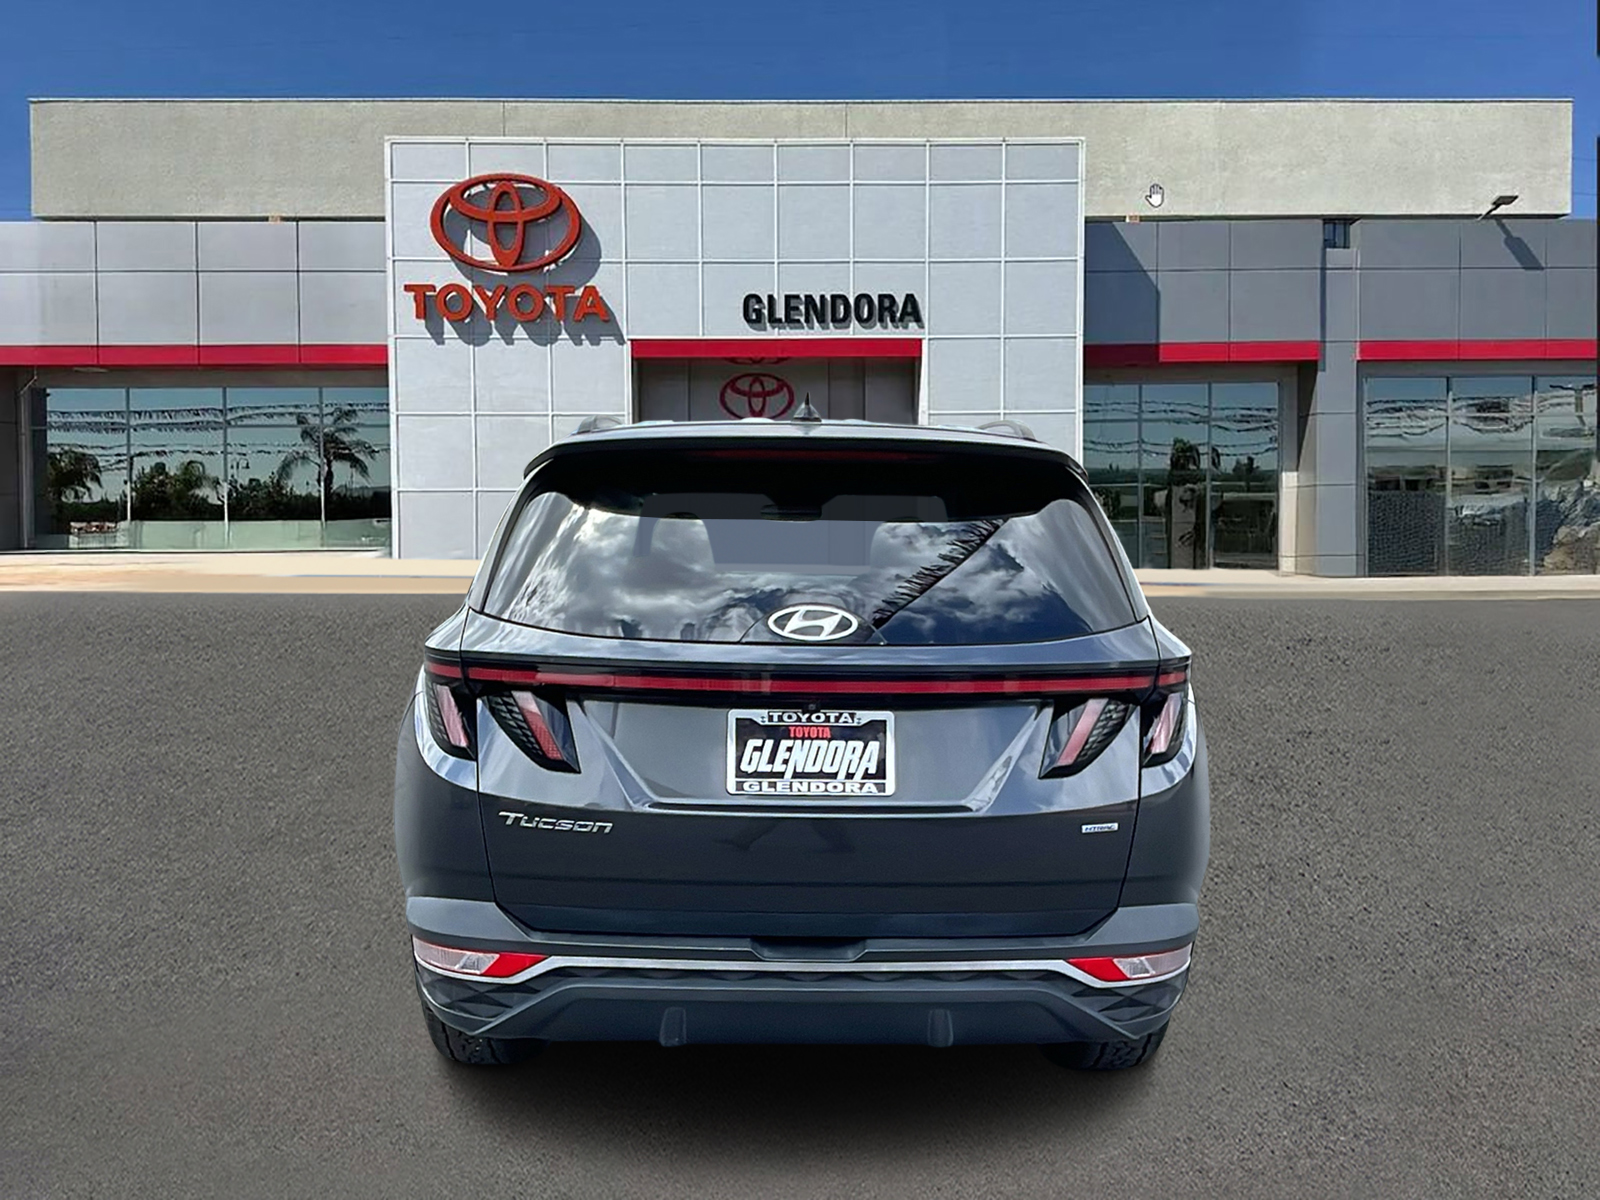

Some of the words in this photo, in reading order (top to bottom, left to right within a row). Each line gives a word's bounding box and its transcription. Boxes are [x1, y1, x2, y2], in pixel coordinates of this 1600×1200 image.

[404, 283, 610, 322] TOYOTA
[743, 293, 923, 326] GLENDORA
[768, 711, 854, 724] TOYOTA
[789, 726, 831, 738] TOYOTA
[740, 738, 880, 780] GLENDORA
[743, 781, 878, 793] GLENDORA
